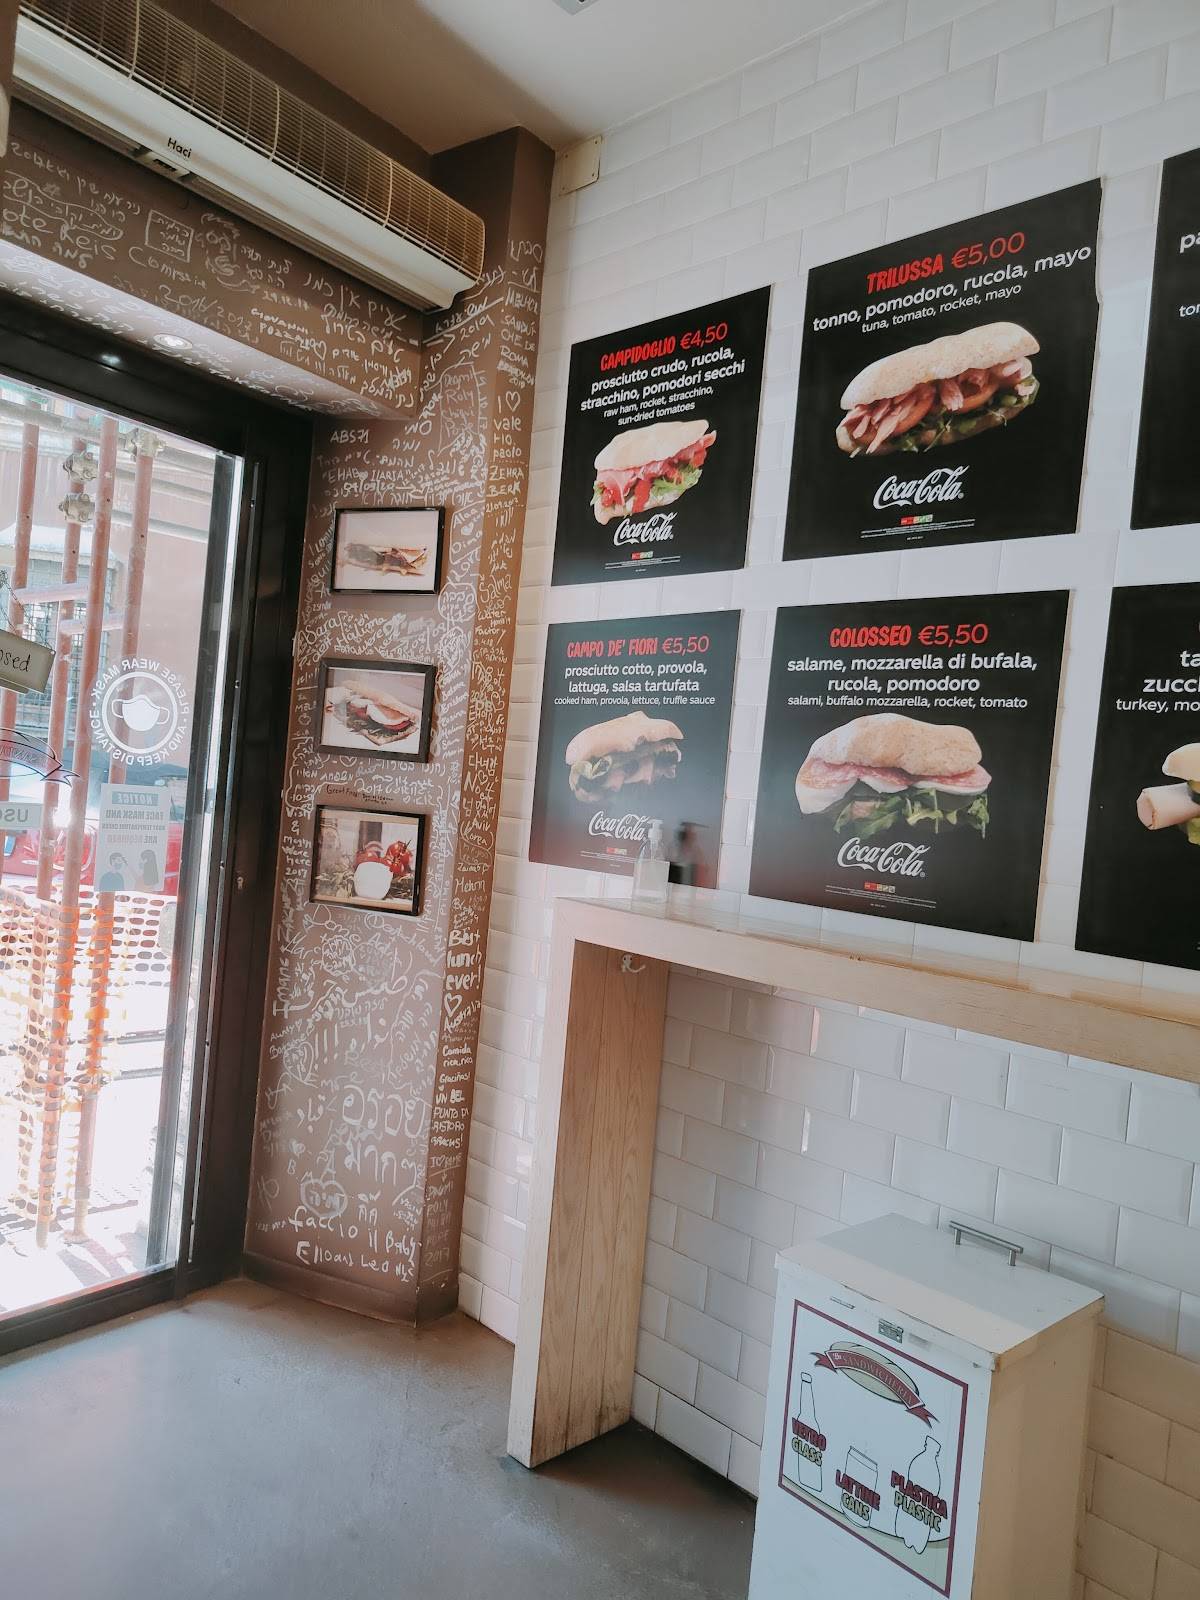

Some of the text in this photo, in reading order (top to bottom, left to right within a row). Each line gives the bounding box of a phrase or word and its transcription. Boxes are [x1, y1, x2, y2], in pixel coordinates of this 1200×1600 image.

[867, 231, 1025, 294] TRILUSSA €5,00
[813, 246, 1092, 332] tonno, pomodoro, rucola, mayo
[862, 284, 1022, 334] tuna, tomato, rocket, mayo
[600, 322, 728, 371] CAMPIDOGLIO €4,50
[580, 359, 746, 411] stracchino, pomodori secchi
[591, 347, 734, 395] prosciutto crudo, rucola,
[603, 385, 714, 418] raw ham, rocket, stracchino,
[617, 401, 696, 426] sun-dried tomatoes
[488, 465, 524, 481] ZEHRA
[873, 465, 970, 510] Coca-Cola
[614, 512, 678, 546] Coca-Cola
[566, 635, 710, 658] CAMPO DE' FIORI €5,50
[829, 623, 989, 648] COLOSSEO €5,50
[565, 660, 708, 679] prosciutto cotto, provola,
[787, 652, 1038, 673] salame, mozzarella di bufala,
[568, 679, 700, 695] lattuga, salsa tartufata
[827, 676, 980, 694] rucola, pomodoro
[554, 695, 715, 707] cooked ham, provola, lettuce, truffle sauce
[787, 695, 1027, 709] salami, buffalo mozzarella, rocket, tomato
[1116, 699, 1169, 713] turkey,
[588, 811, 650, 840] Coca-Cola
[837, 837, 931, 877] Coca-Cola
[792, 1417, 827, 1452] VETRO
[791, 1437, 823, 1467] GLASS
[835, 1469, 881, 1511] LATTINE
[891, 1470, 948, 1519] PLASTICA
[841, 1493, 870, 1521] CANS
[894, 1491, 942, 1532] PLASTIC
